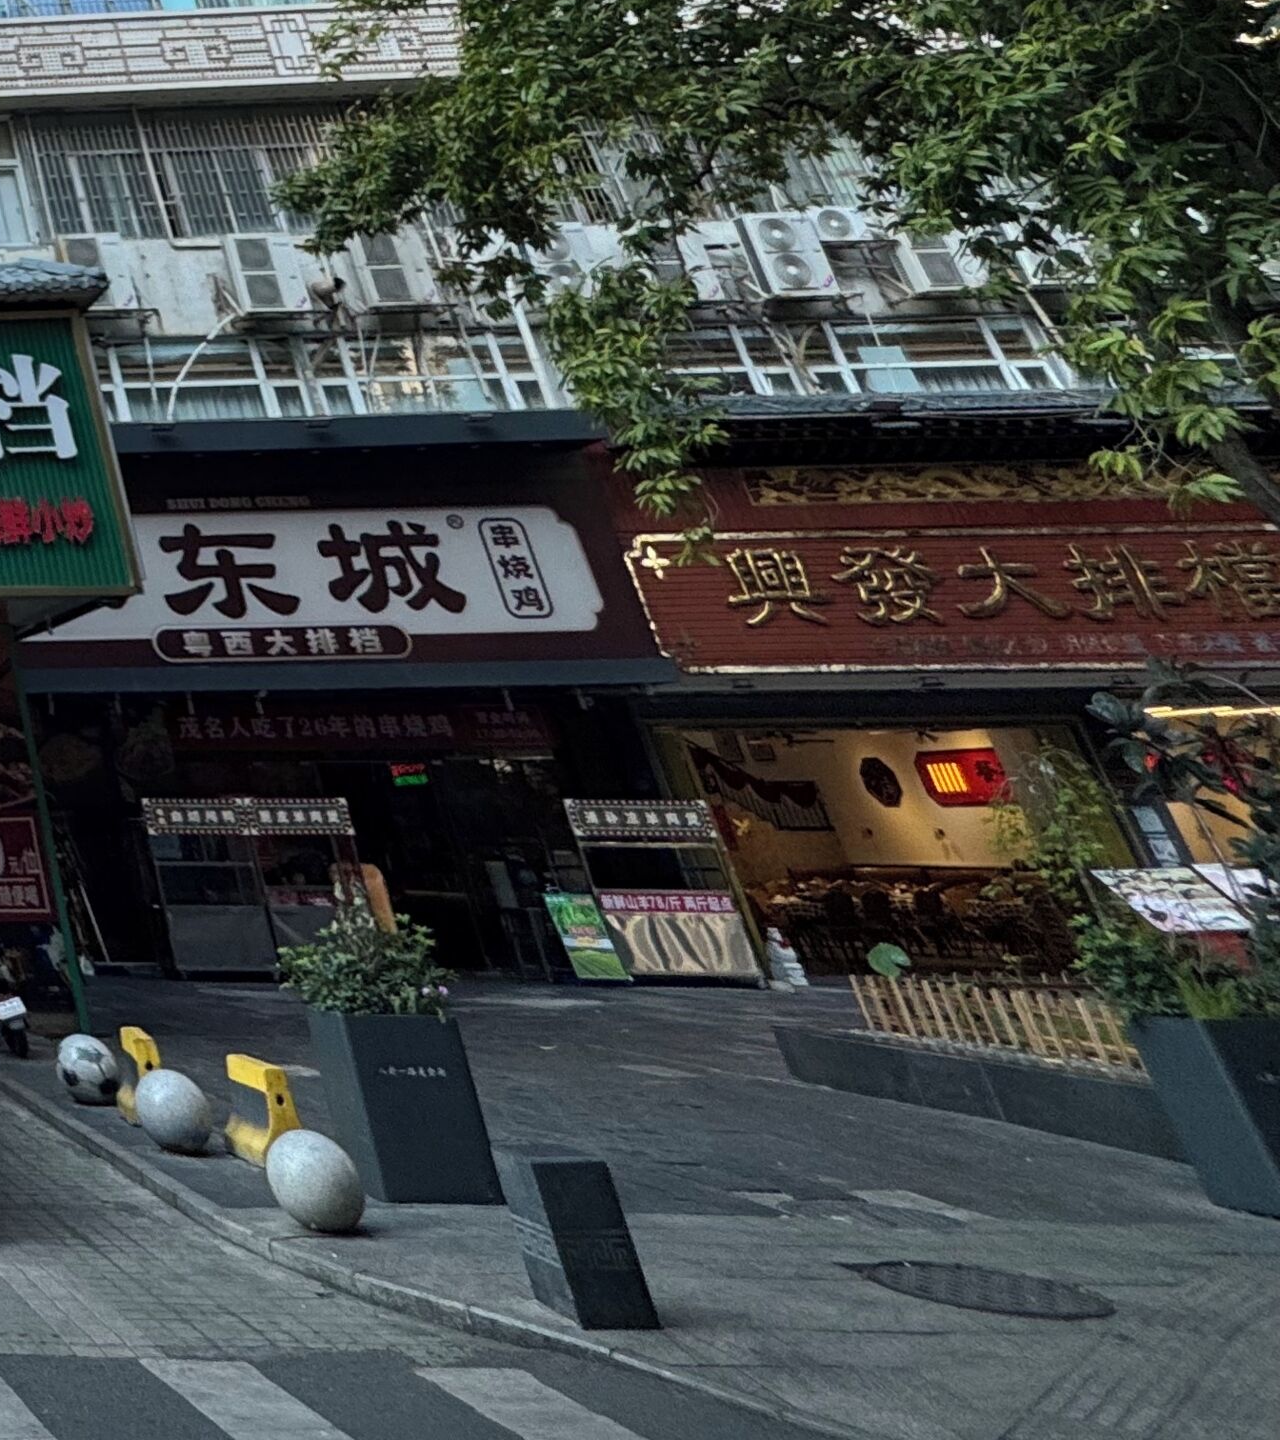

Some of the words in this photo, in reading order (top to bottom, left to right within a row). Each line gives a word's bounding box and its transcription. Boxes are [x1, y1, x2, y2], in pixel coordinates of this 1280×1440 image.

[166, 497, 207, 512] SHUI
[209, 497, 252, 511] DONG
[158, 519, 467, 619] 东城
[489, 524, 545, 612] 串烧鸡
[182, 627, 384, 657] 粤西大排档
[177, 713, 454, 738] 茂名人吃了26年的串烧鸡
